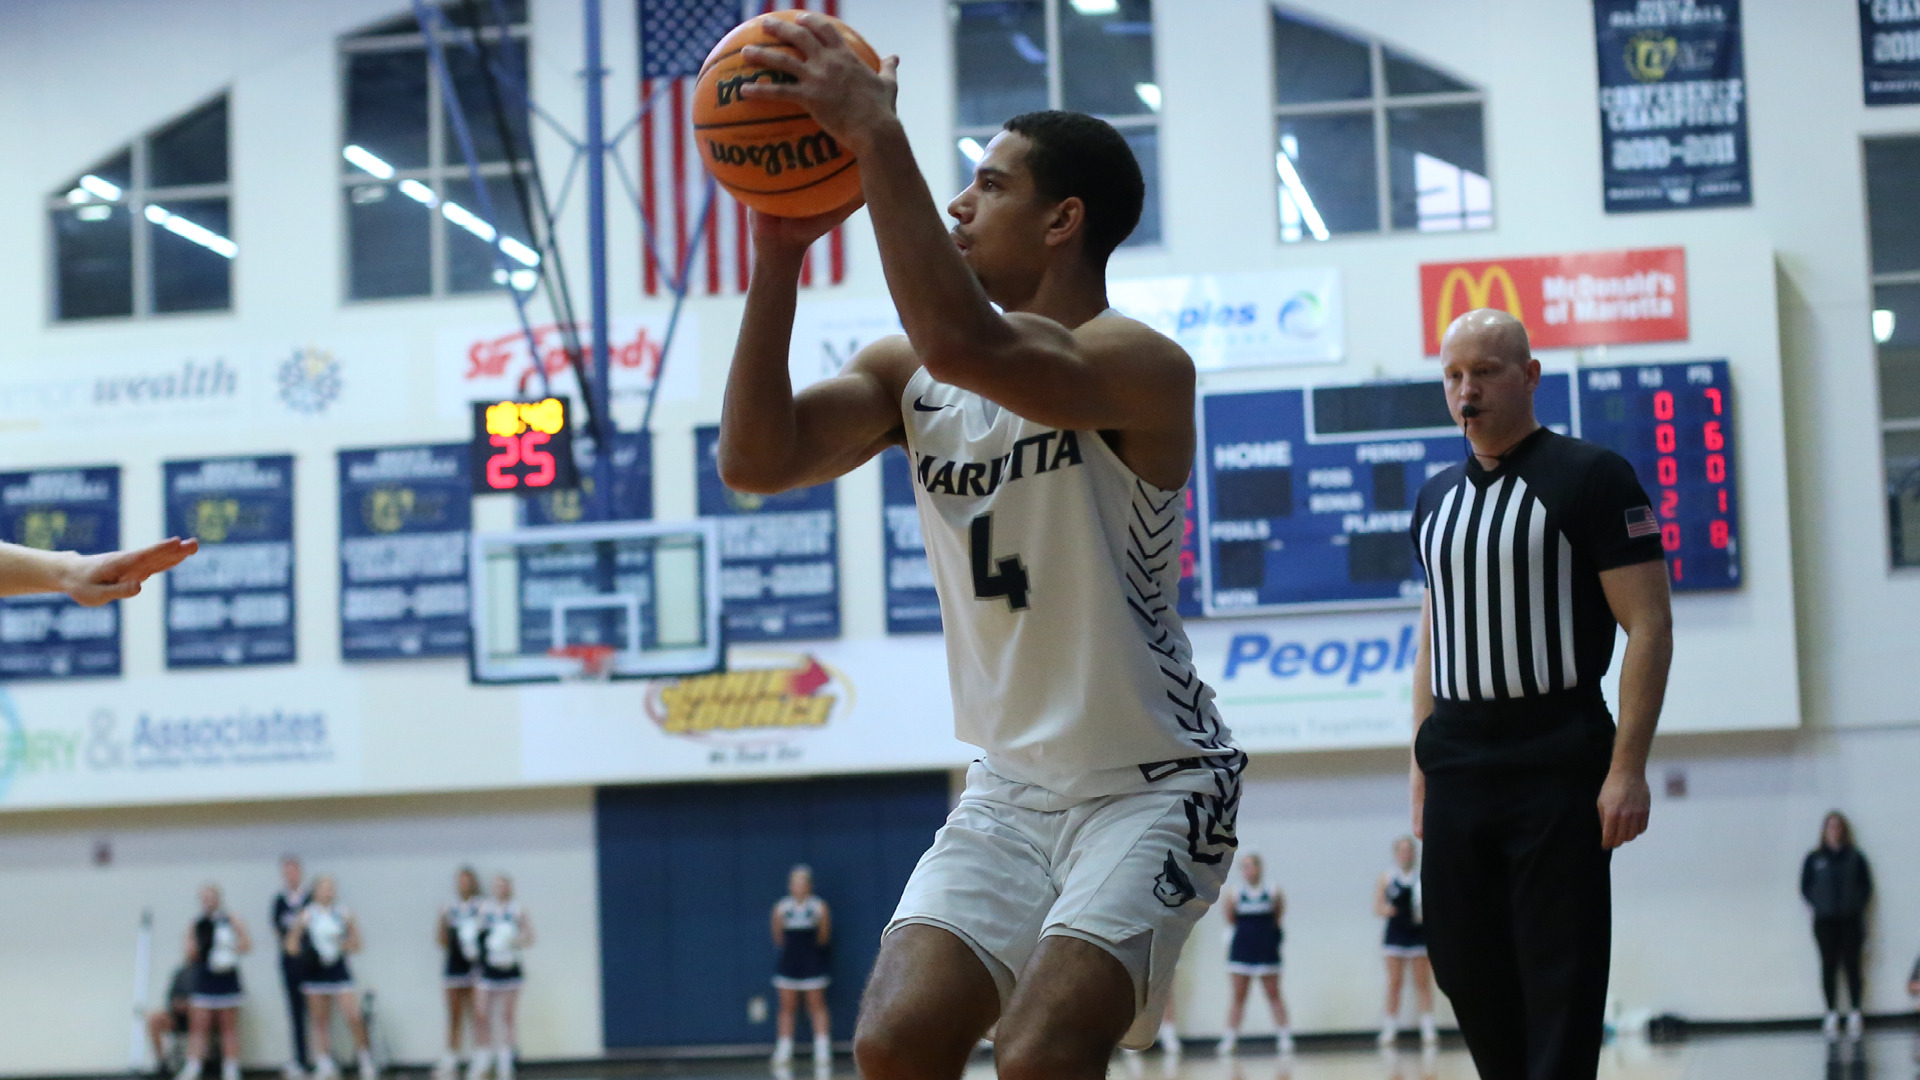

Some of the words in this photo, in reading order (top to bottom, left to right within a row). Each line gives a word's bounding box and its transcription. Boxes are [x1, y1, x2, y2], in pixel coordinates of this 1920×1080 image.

[708, 129, 842, 176] Wilson
[1542, 269, 1675, 300] McDonald's
[1573, 297, 1674, 323] Marietta
[92, 354, 238, 405] wealth
[1654, 390, 1674, 421] 0
[1704, 387, 1722, 416] 7
[1655, 422, 1676, 454] 0
[1704, 420, 1724, 451] 6
[486, 431, 556, 489] 25
[1213, 440, 1292, 469] HOME
[1657, 455, 1678, 486] 0
[1706, 452, 1726, 484] 0
[1660, 488, 1679, 519] 2
[1661, 521, 1681, 552] 0
[1710, 519, 1730, 549] 8
[968, 511, 1032, 614] 4
[132, 702, 329, 748] Associates
